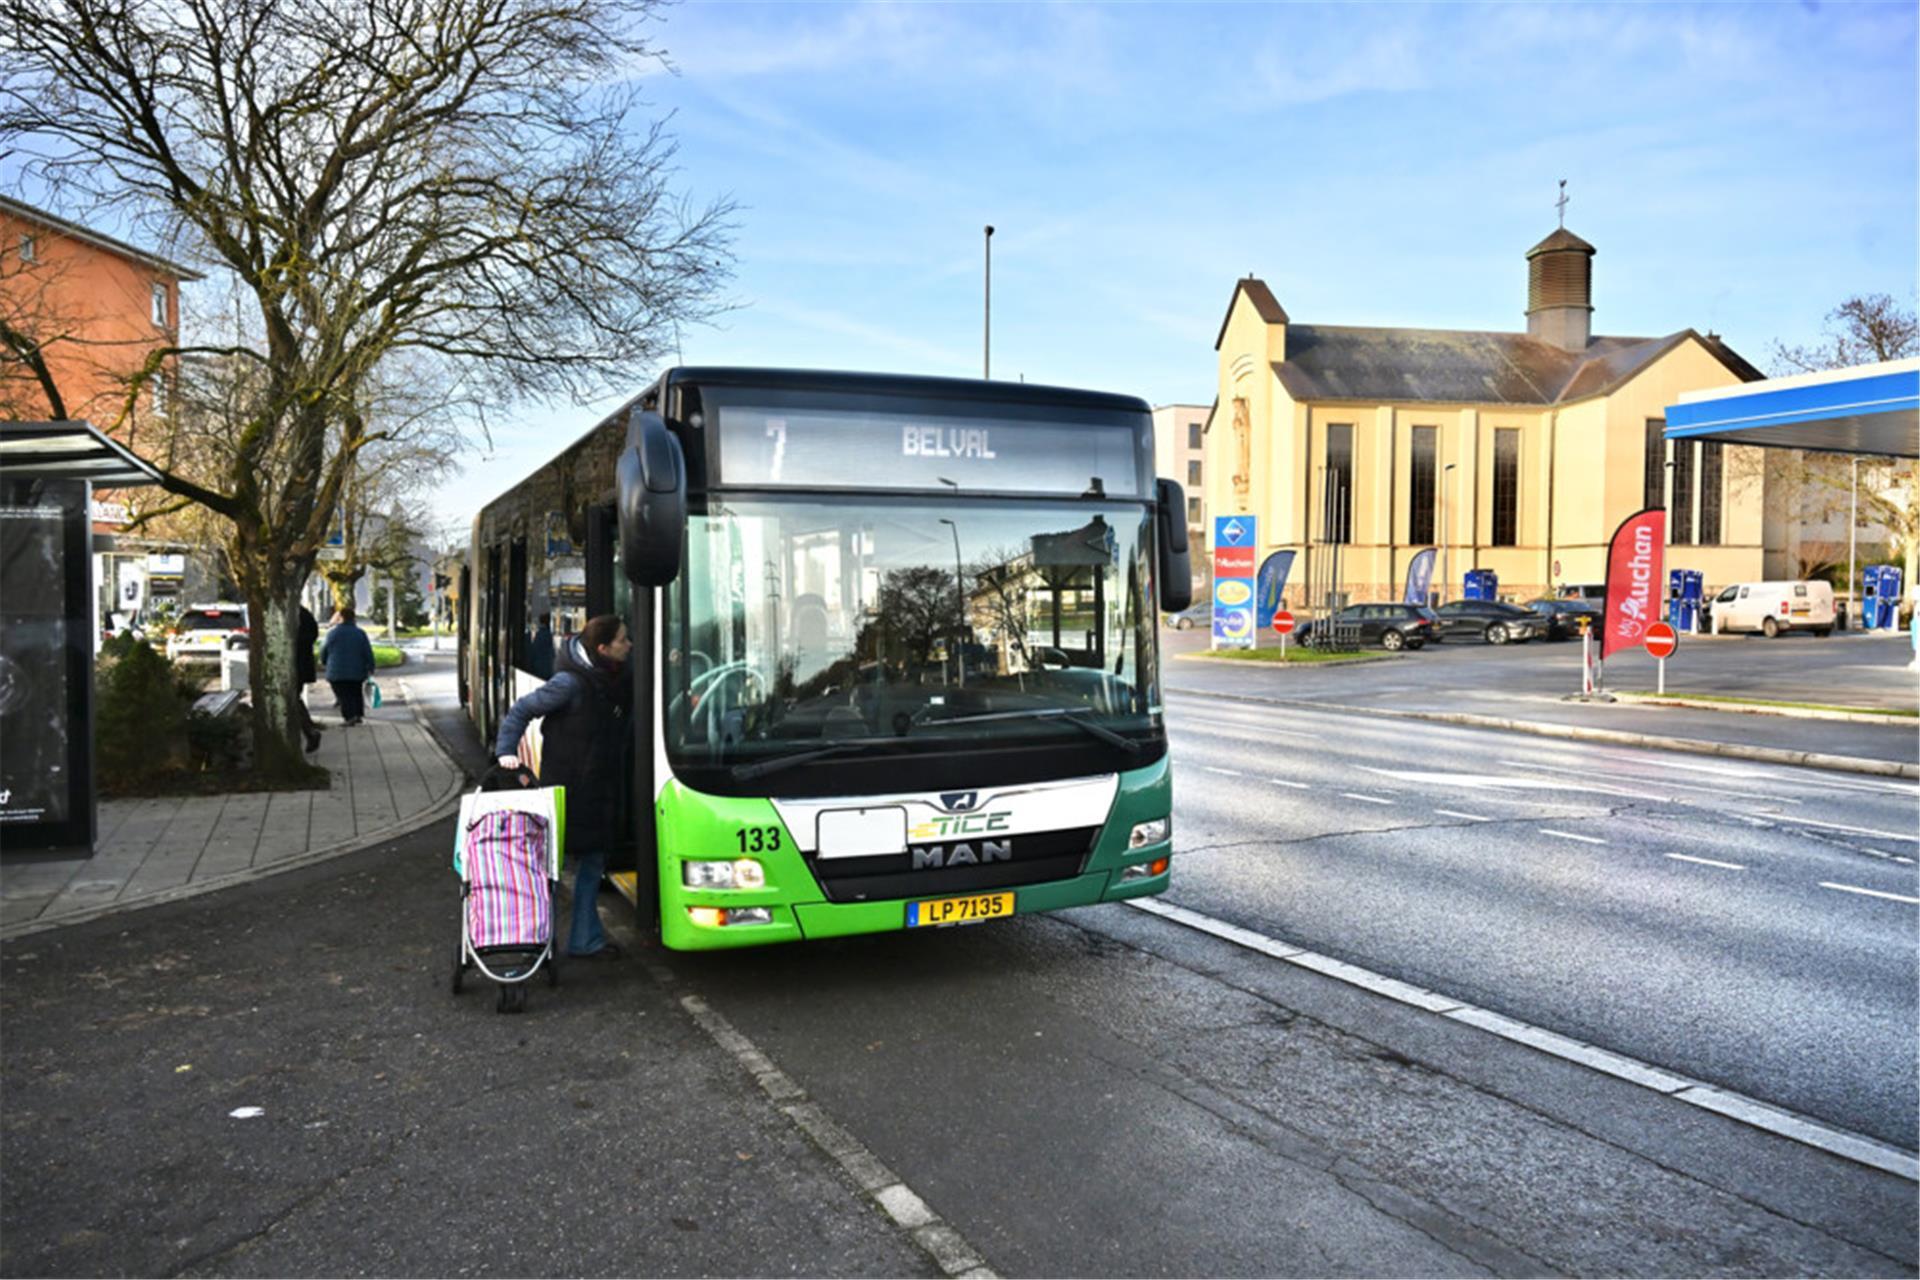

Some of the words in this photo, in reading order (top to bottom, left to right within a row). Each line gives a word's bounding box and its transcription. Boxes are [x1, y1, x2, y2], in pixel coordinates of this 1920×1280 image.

[766, 420, 786, 481] 7
[902, 425, 996, 459] BELVAL
[1619, 525, 1652, 621] Auchan
[736, 826, 781, 853] 133
[912, 840, 1012, 870] MAN
[929, 901, 954, 922] LP
[958, 896, 1003, 918] 7135
